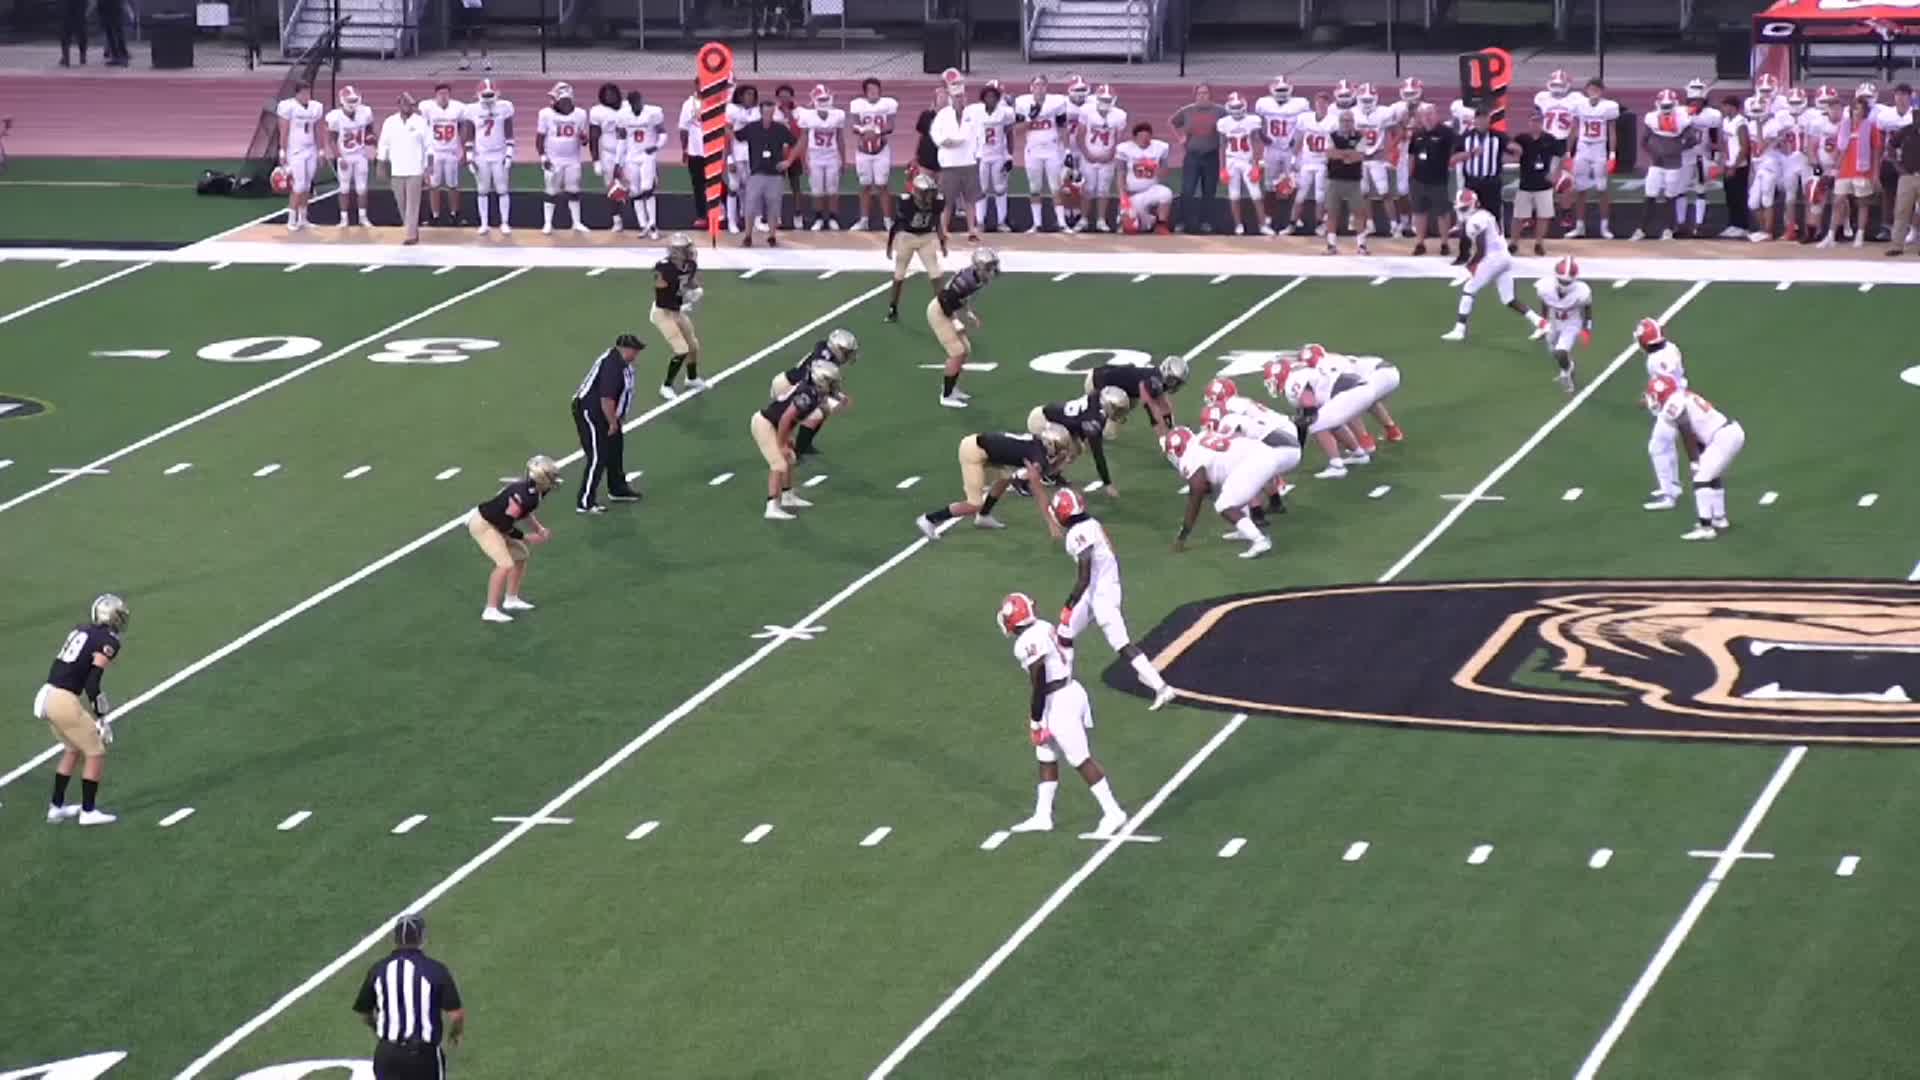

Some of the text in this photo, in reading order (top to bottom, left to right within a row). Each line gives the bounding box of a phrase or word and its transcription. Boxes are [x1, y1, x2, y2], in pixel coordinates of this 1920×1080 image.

[483, 119, 495, 137] 7
[1270, 119, 1288, 137] 61
[814, 131, 833, 147] 57
